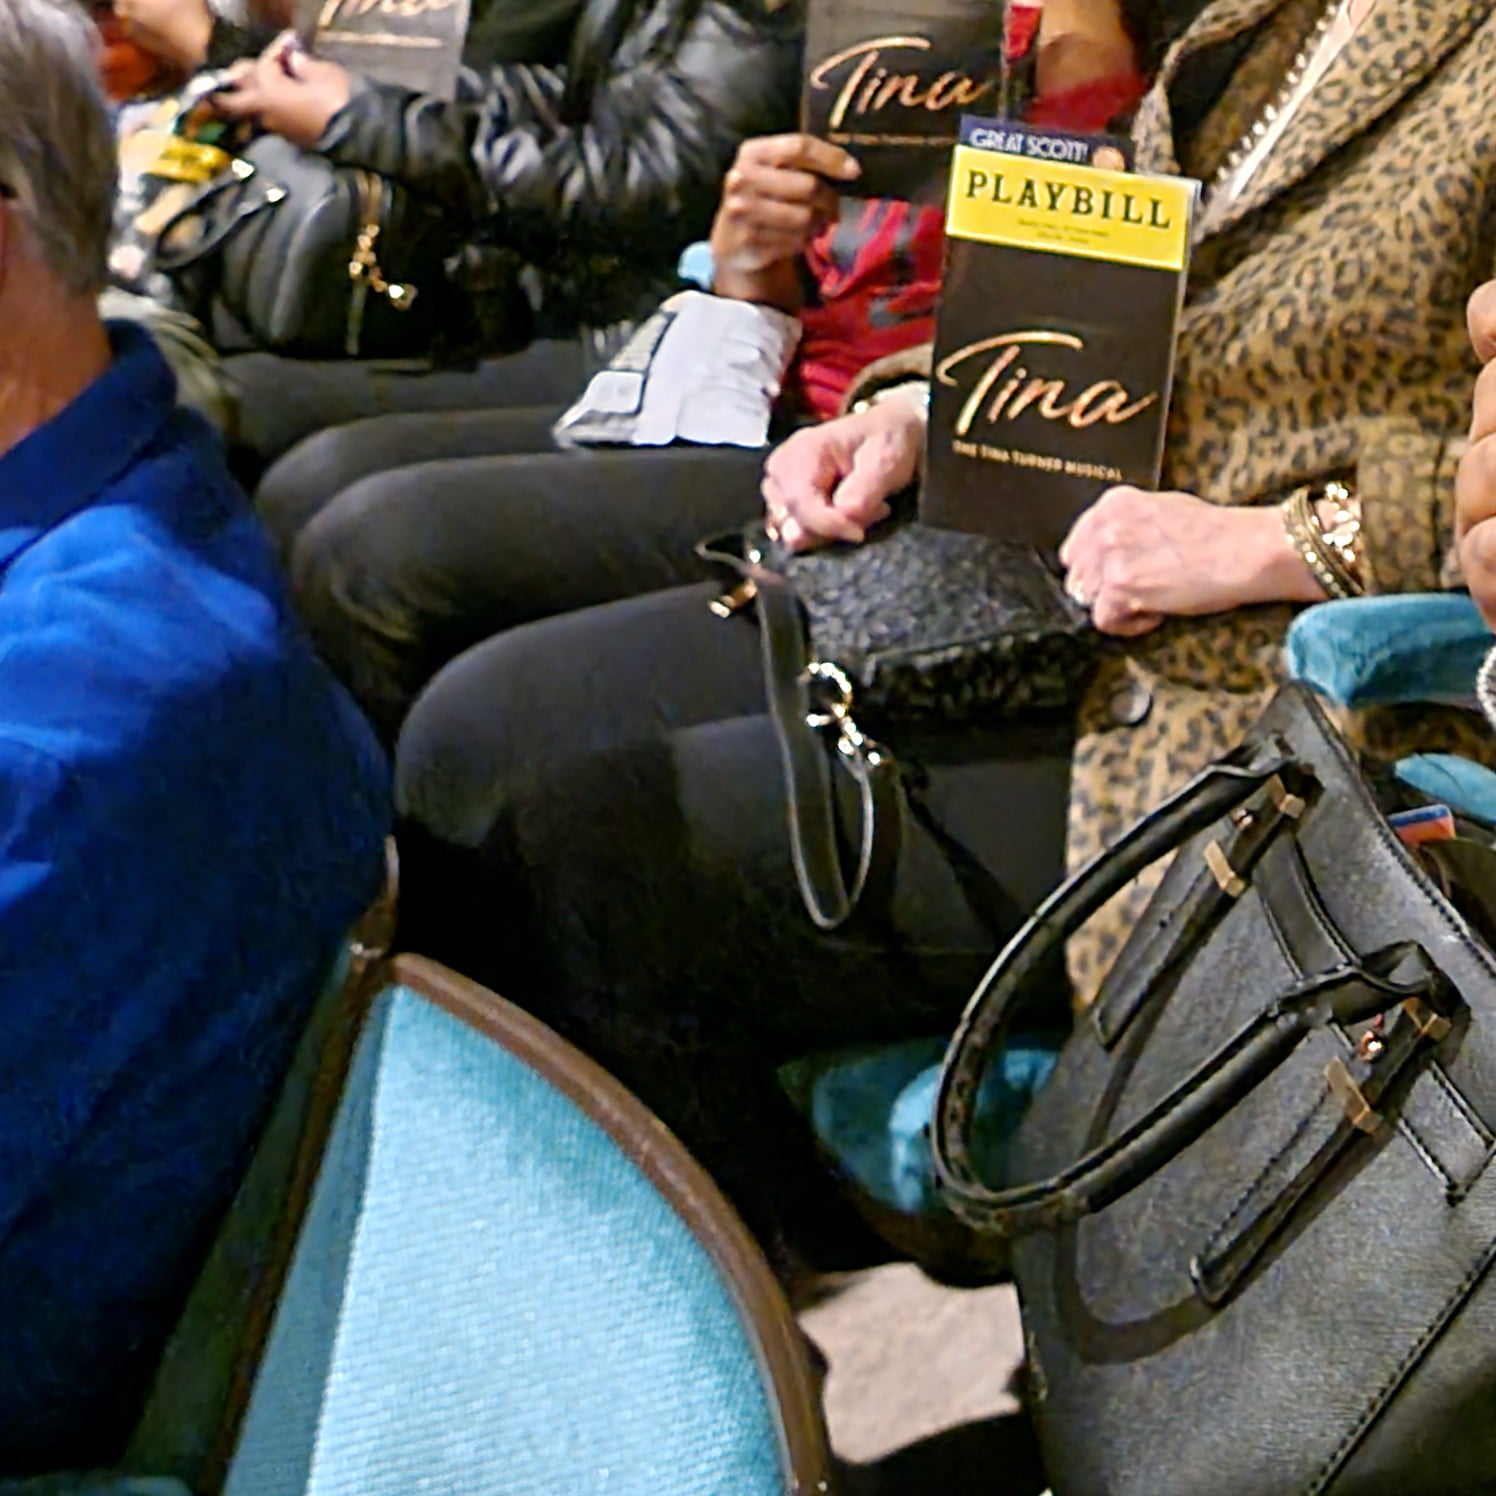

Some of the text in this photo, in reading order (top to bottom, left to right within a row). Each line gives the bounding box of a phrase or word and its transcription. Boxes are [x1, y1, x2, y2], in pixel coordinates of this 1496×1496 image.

[810, 36, 994, 129] Tina
[966, 169, 1171, 229] PLAYBILL
[936, 329, 1158, 436] Tina
